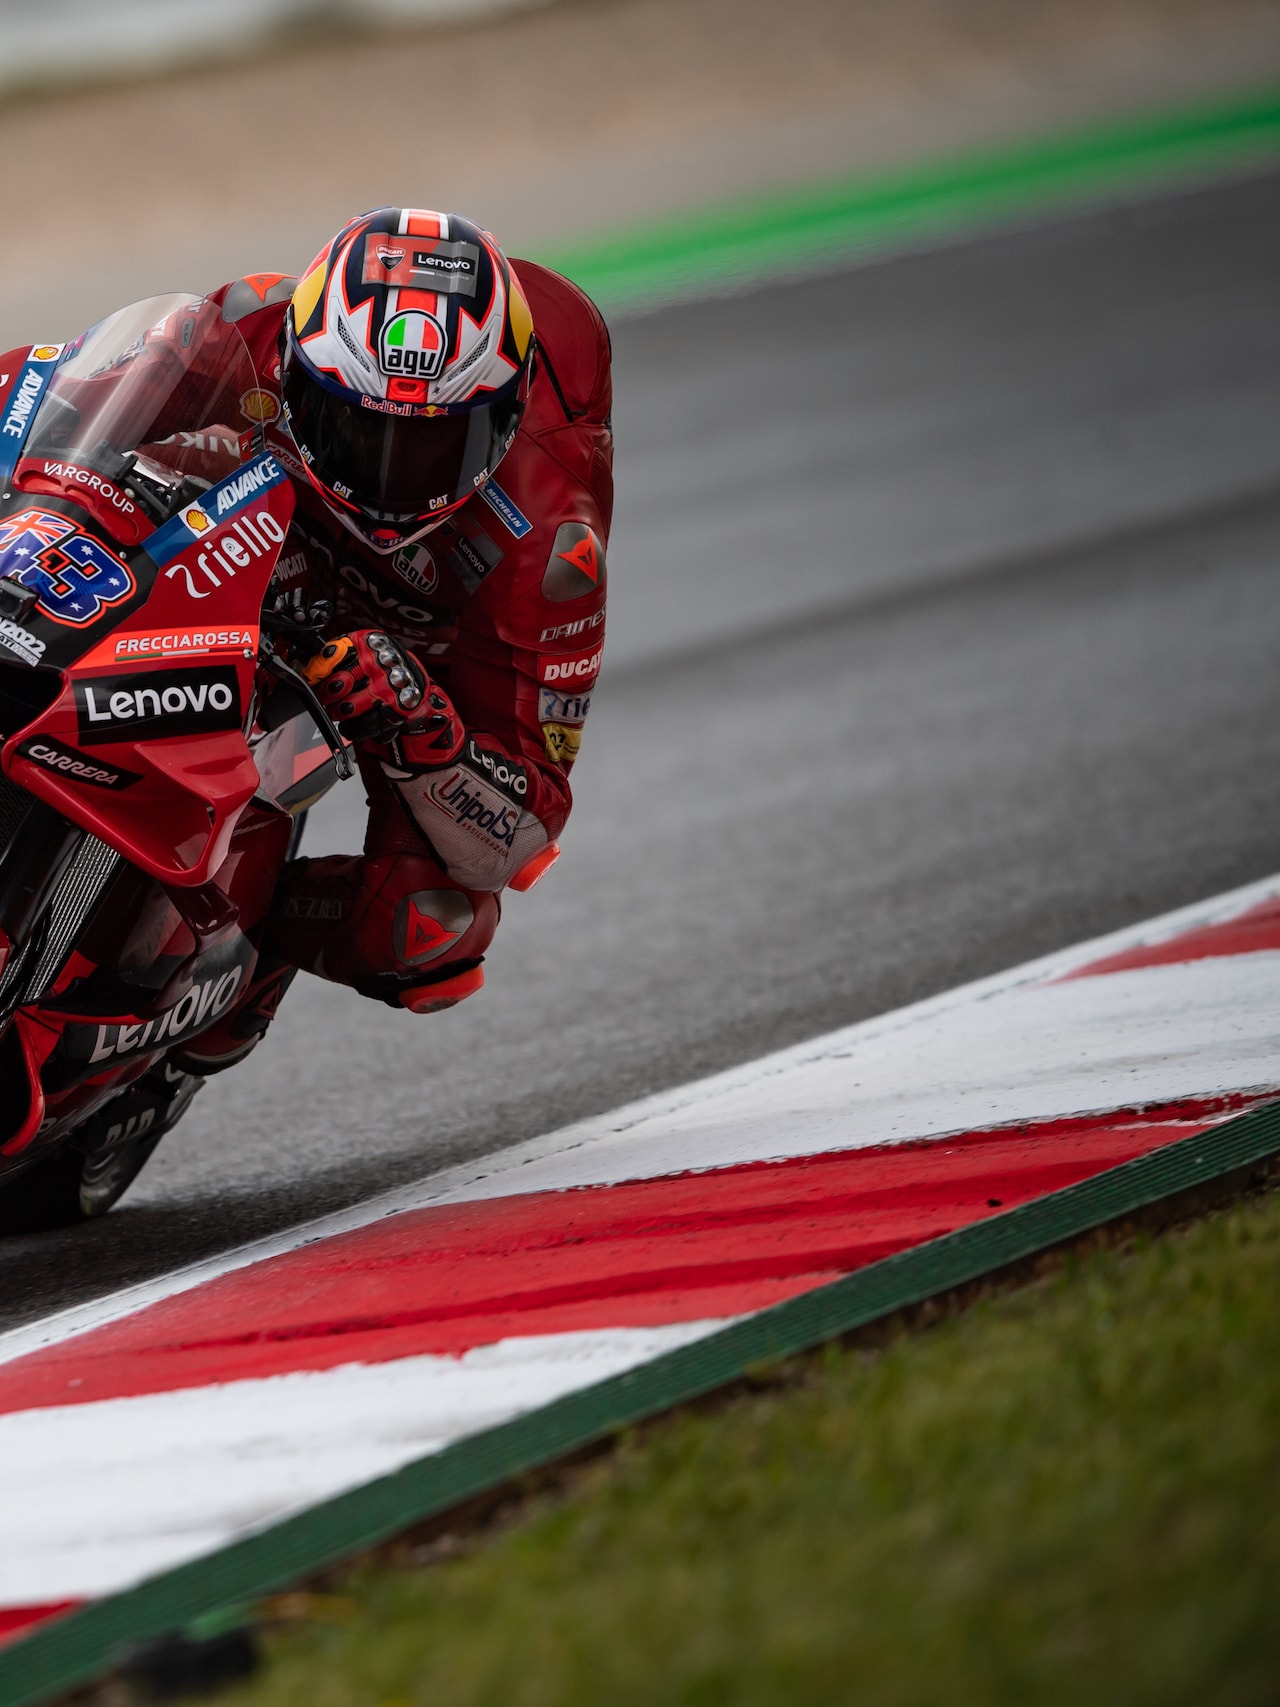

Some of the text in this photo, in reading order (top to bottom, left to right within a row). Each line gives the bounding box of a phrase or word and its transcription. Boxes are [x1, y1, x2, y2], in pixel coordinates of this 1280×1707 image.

[379, 246, 403, 255] DUCATI
[418, 254, 471, 270] Lenovo
[387, 348, 437, 375] agv
[3, 367, 44, 439] ADVANCE
[282, 400, 293, 421] CAT
[361, 394, 413, 417] Red Bull
[504, 428, 516, 450] CAT
[300, 443, 316, 465] CAT
[42, 461, 136, 515] VARGROUP
[215, 454, 280, 516] ADVANCE
[473, 466, 489, 487] CAT
[332, 480, 353, 500] CAT
[428, 493, 449, 511] CAT
[486, 488, 523, 529] MICHELIN
[458, 536, 485, 573] Lenovo
[397, 557, 430, 590] agv
[115, 630, 253, 655] FRECCIAROSSA
[84, 682, 233, 722] Lenovo
[28, 744, 119, 785] CARRERA
